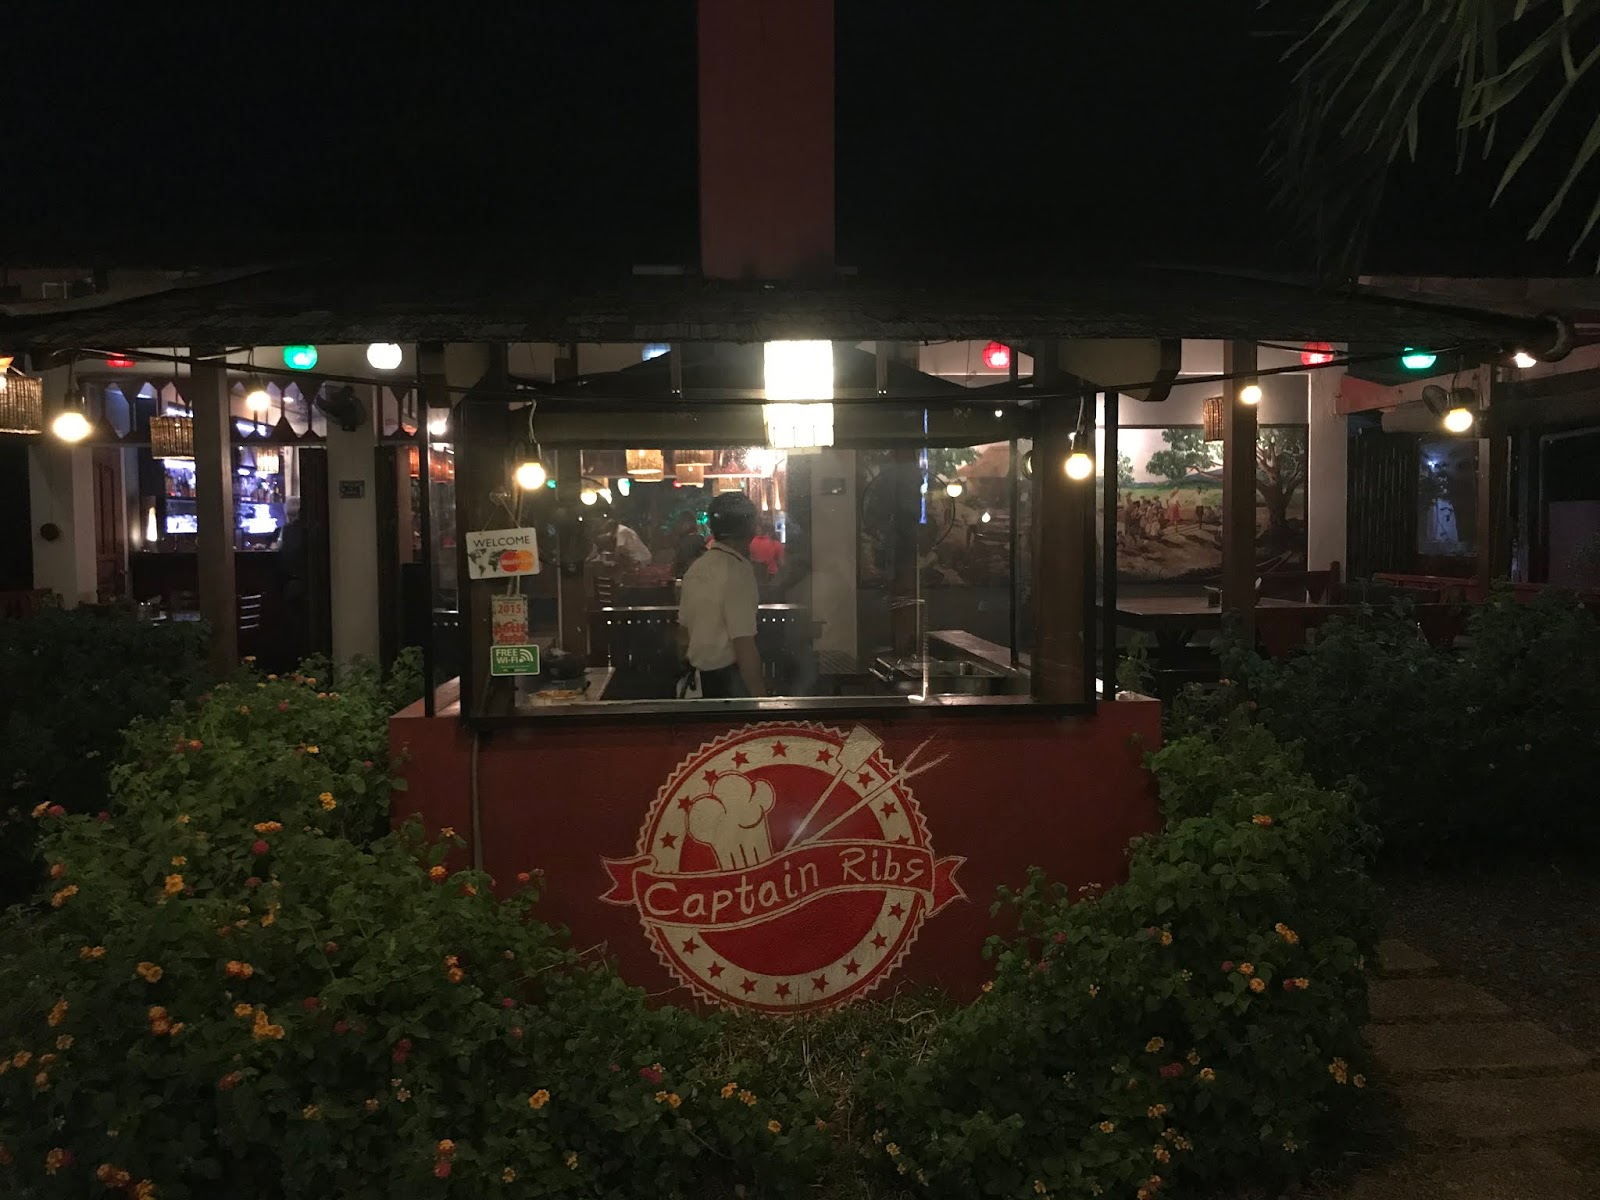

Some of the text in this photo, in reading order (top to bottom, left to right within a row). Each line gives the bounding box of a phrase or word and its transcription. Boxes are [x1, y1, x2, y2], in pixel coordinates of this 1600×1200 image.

[473, 535, 531, 548] WELCOME
[498, 604, 522, 614] 2015
[495, 648, 518, 657] FREE
[496, 656, 519, 664] WI-FI
[644, 847, 925, 922] Captain Ribs
